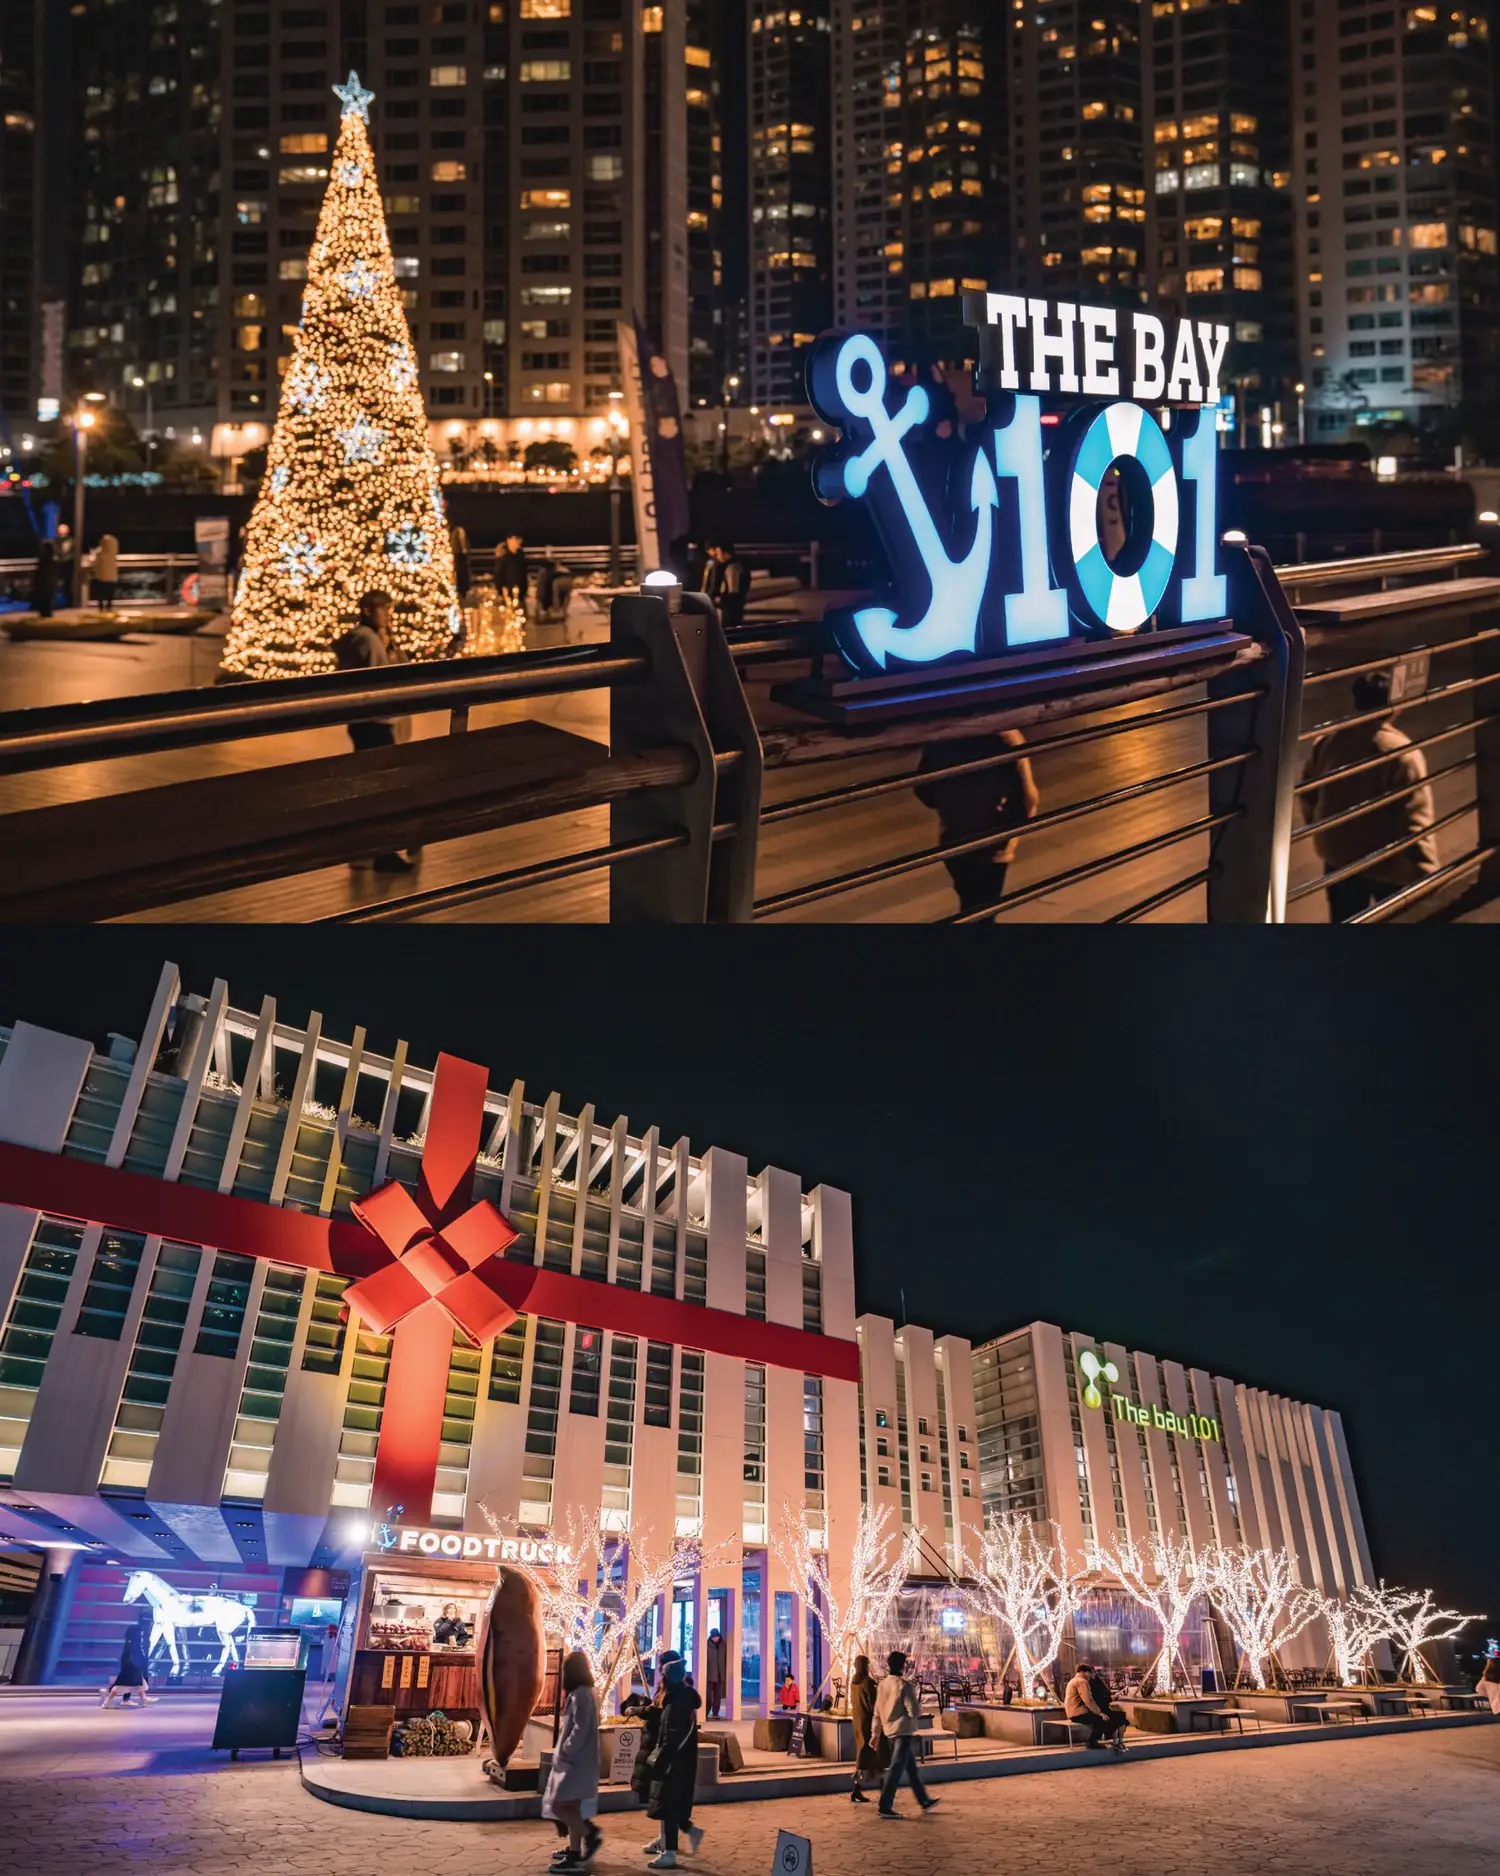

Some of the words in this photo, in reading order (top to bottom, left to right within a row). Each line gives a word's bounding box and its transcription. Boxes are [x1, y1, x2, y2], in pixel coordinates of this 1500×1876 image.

[986, 292, 1120, 396] THE
[1133, 312, 1230, 403] BAY
[994, 394, 1227, 646] 101
[1111, 1394, 1150, 1427] The
[1152, 1403, 1189, 1440] bay
[1190, 1413, 1220, 1442] 101
